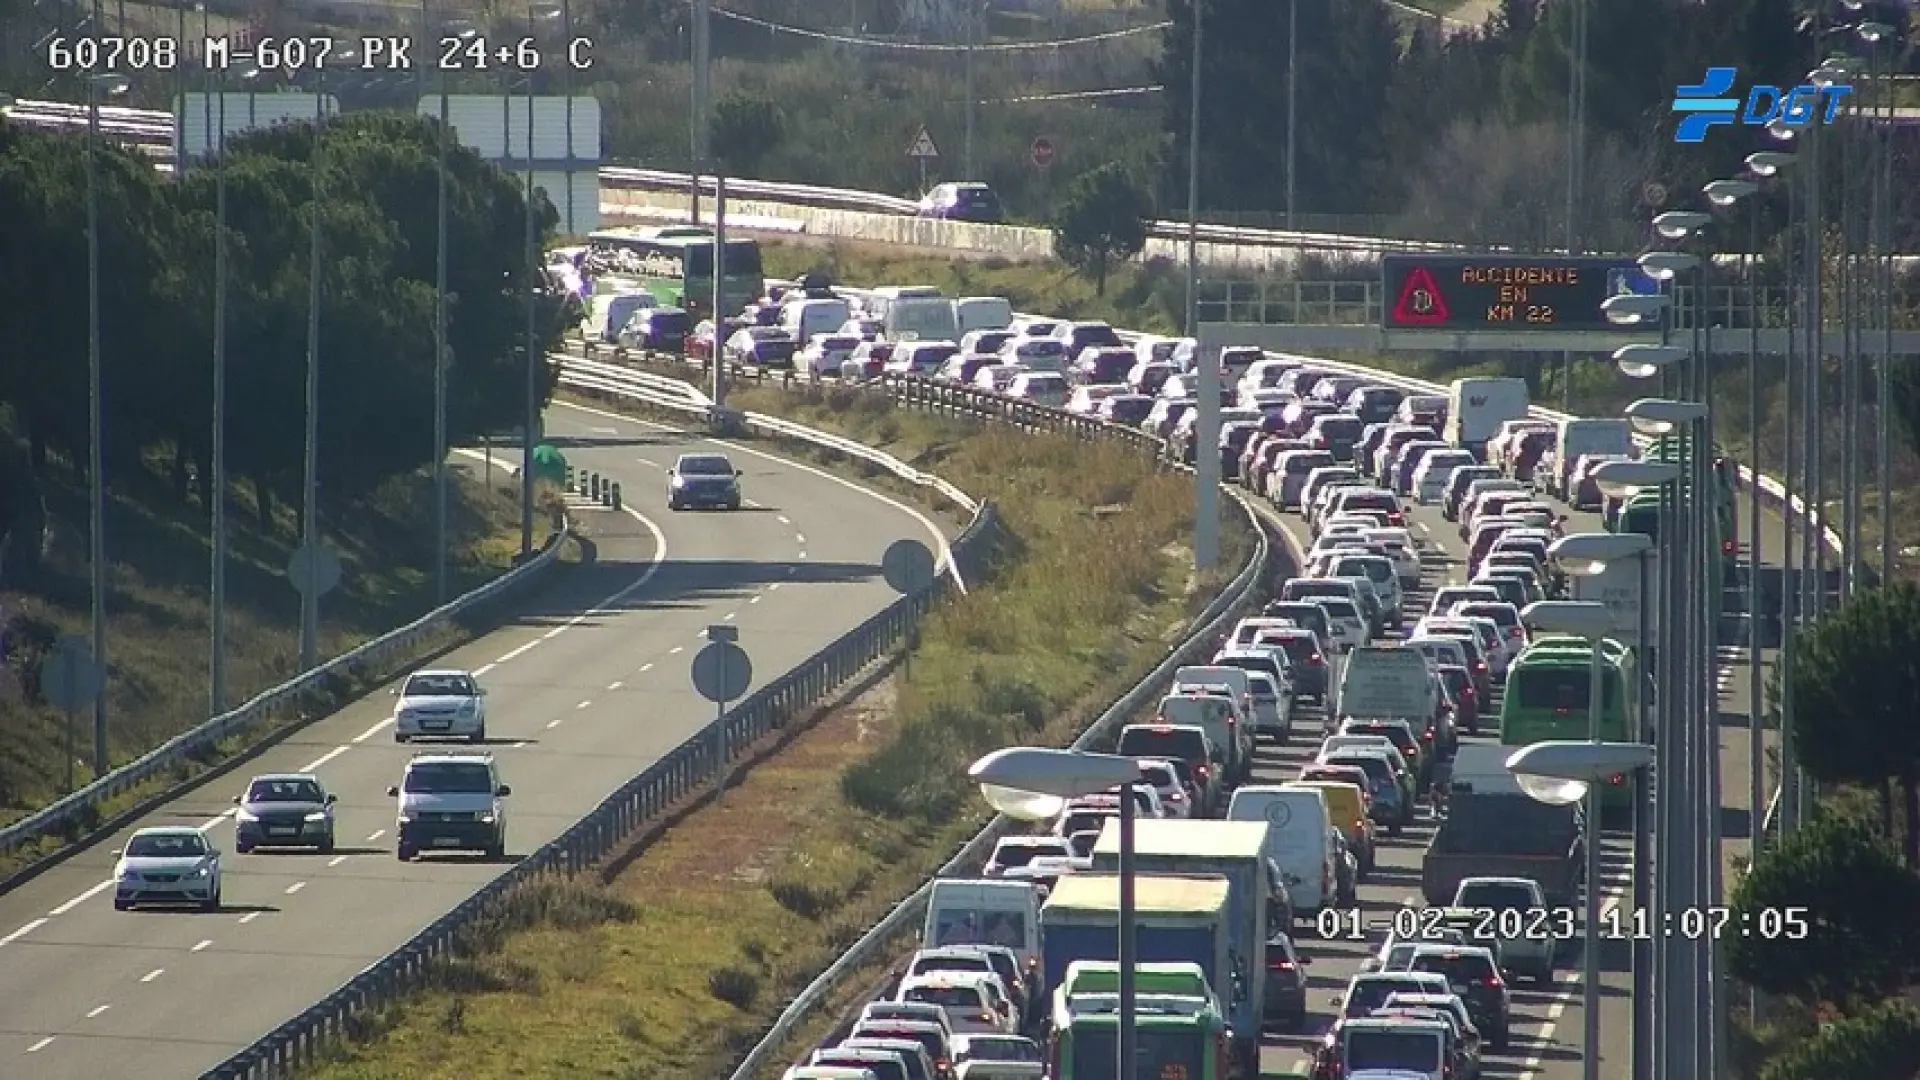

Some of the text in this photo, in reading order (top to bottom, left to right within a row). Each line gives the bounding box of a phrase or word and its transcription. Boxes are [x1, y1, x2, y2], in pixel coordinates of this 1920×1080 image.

[1462, 266, 1579, 285] ACCIDENTE
[1500, 286, 1528, 302] EN
[1486, 305, 1553, 322] KM 22
